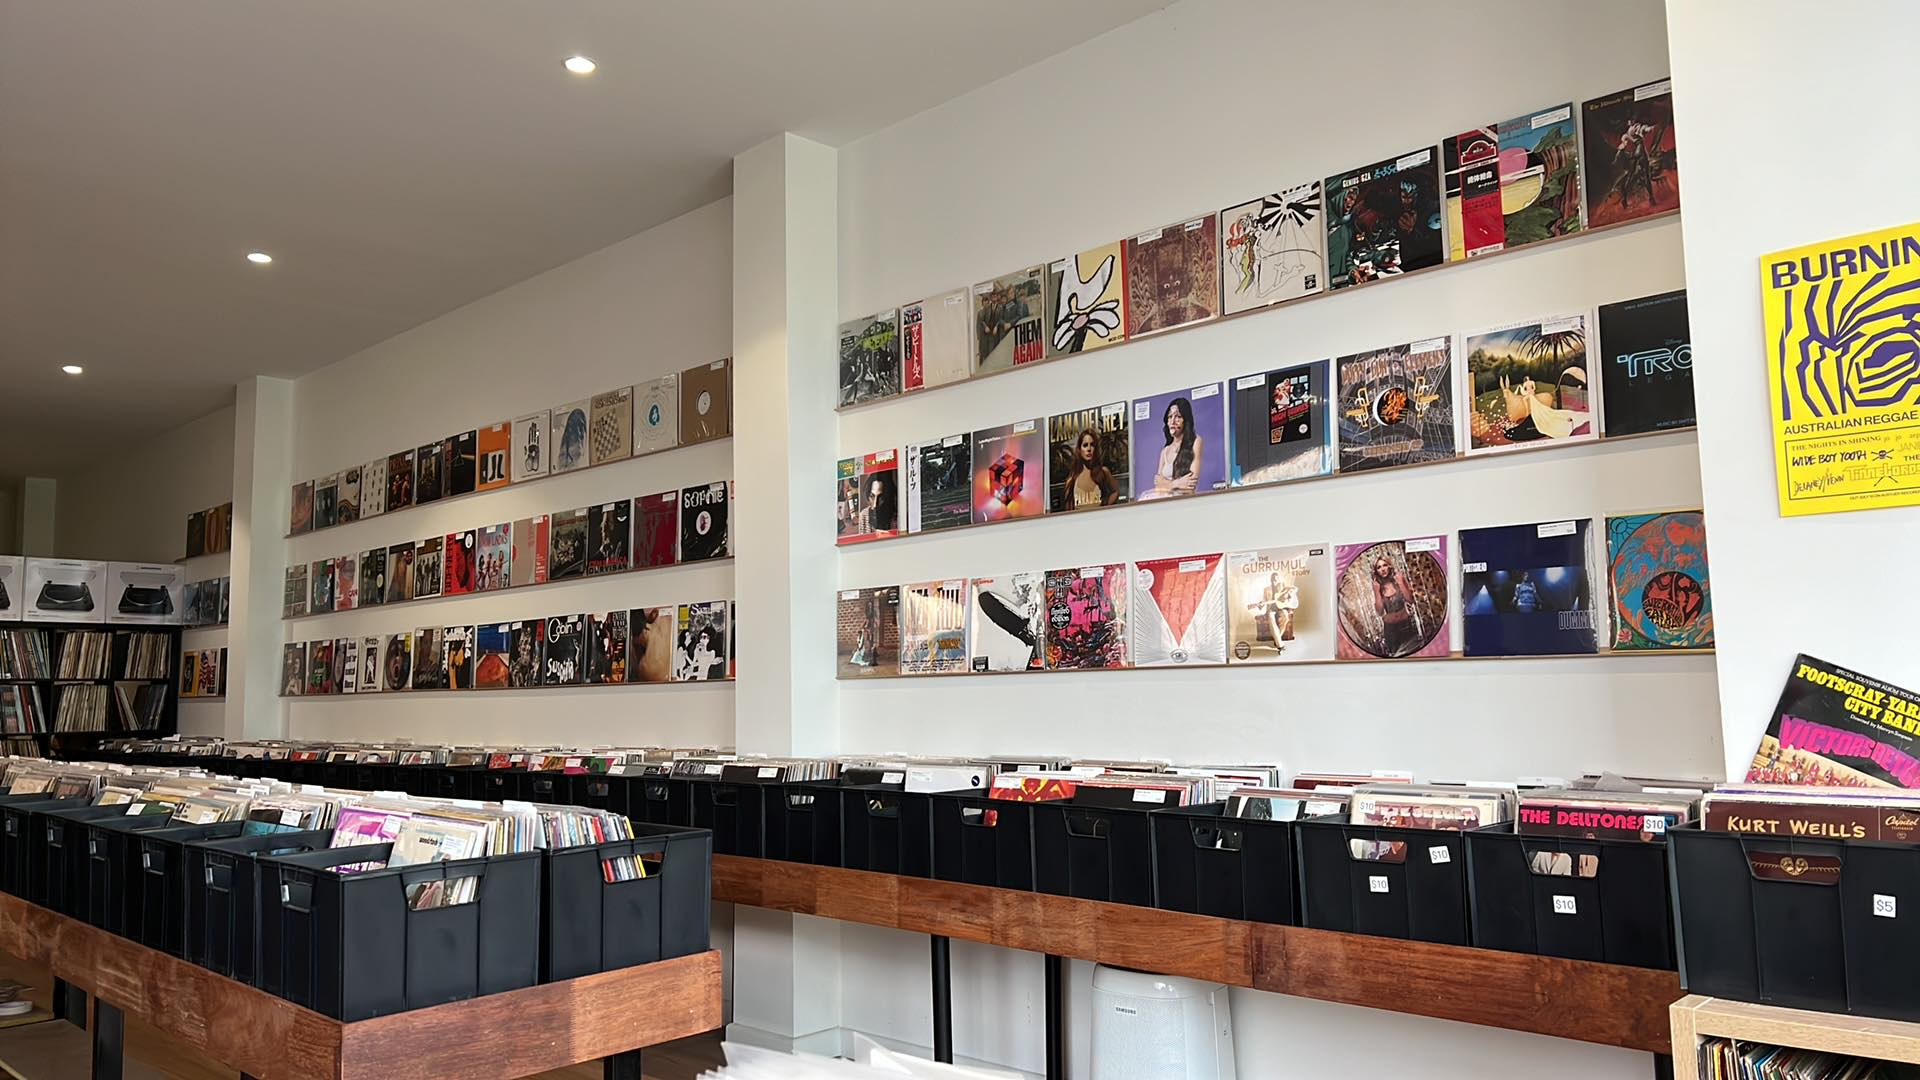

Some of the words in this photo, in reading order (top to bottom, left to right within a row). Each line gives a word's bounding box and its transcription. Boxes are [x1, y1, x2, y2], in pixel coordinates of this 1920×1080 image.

[1014, 318, 1043, 345] THEM
[1013, 341, 1044, 365] AGAIN
[1617, 344, 1693, 378] TRO
[1050, 413, 1079, 442] LANA
[1082, 408, 1101, 433] DEL
[1103, 411, 1125, 432] REY
[1784, 418, 1862, 435] AUSTRALIAN
[1864, 411, 1919, 425] REGGAE
[1792, 456, 1816, 467] WIDE
[1819, 453, 1838, 464] BOY
[1242, 559, 1305, 574] GURRUMUL
[1836, 669, 1855, 679] SPECIAL
[1844, 697, 1882, 719] CITY
[1779, 714, 1877, 758] VICTORS
[1360, 802, 1374, 811] $10
[1520, 809, 1550, 824] THE
[1645, 819, 1663, 829] $10
[1727, 815, 1780, 834] KURT
[1789, 820, 1865, 838] WEILL'S
[1431, 850, 1448, 860] $10
[1371, 880, 1387, 889] $10
[1555, 900, 1574, 910] $10
[1876, 899, 1893, 912] $5
[1115, 1007, 1137, 1015] SAMSUNG
